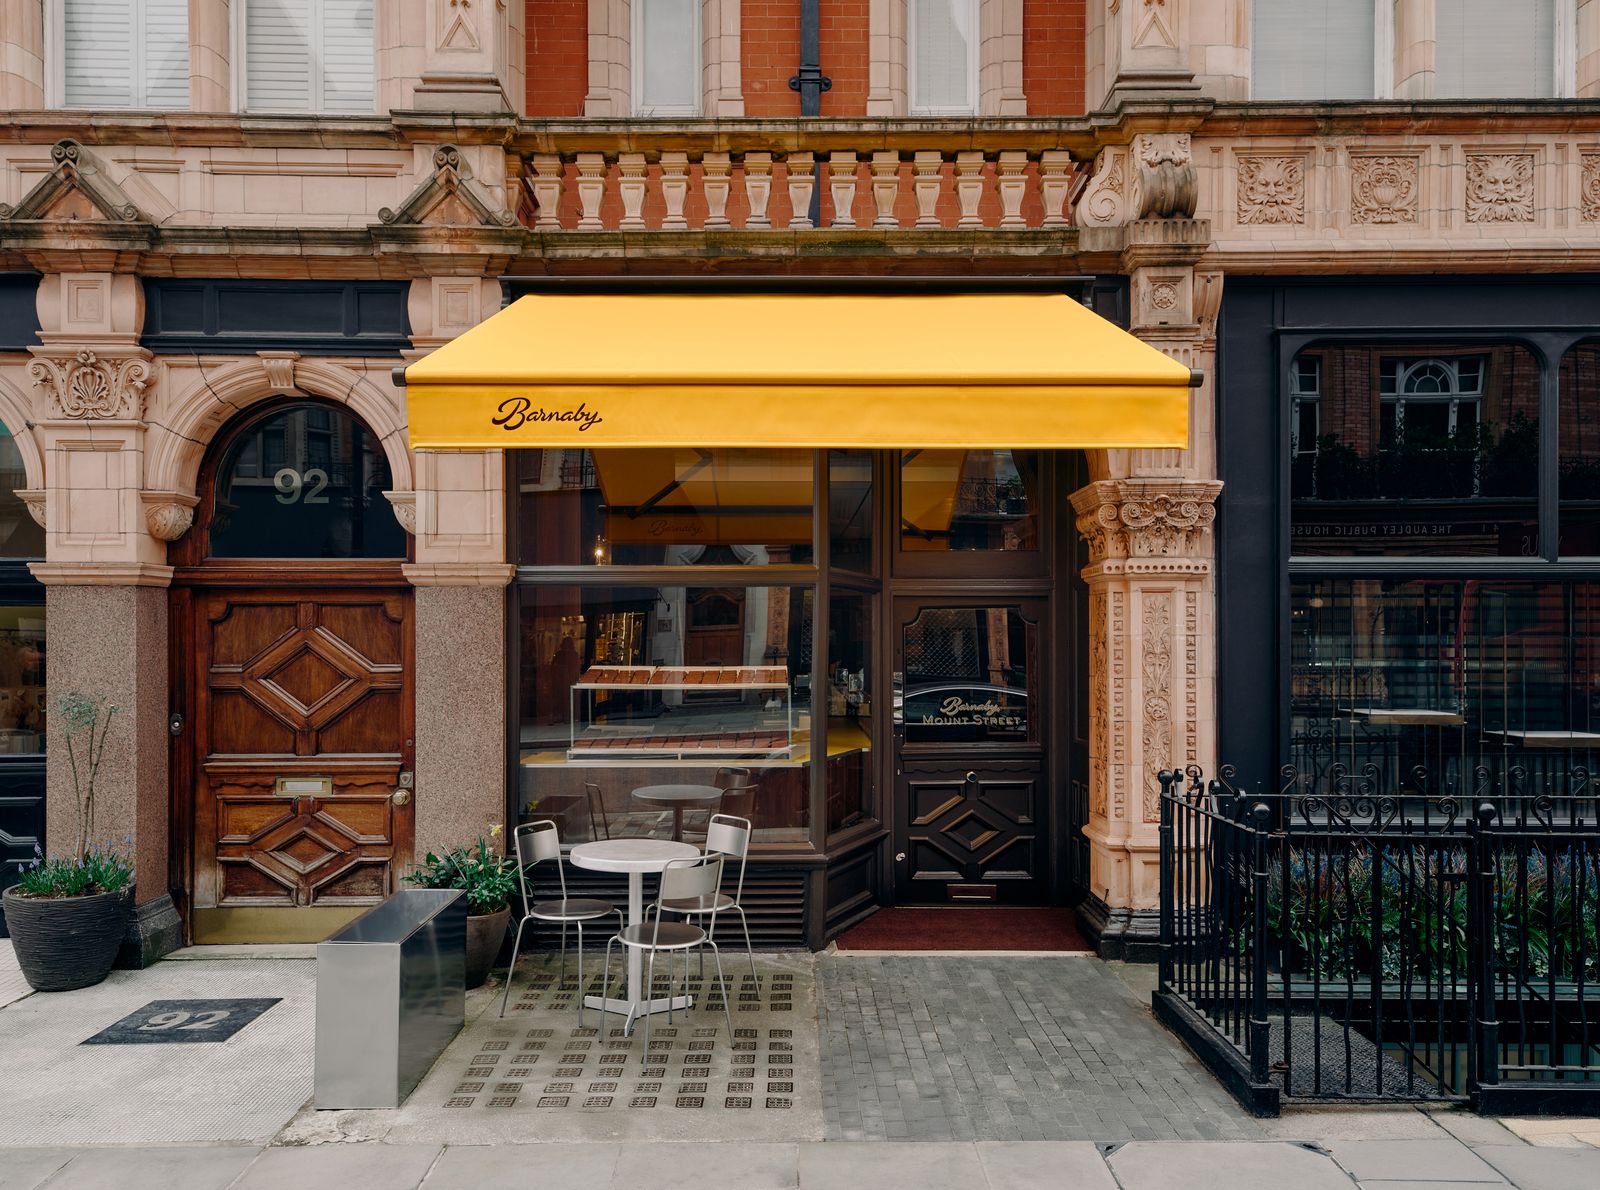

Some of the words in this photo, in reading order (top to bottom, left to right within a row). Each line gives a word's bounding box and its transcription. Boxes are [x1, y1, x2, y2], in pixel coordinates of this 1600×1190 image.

[491, 397, 603, 432] Barnaby
[273, 467, 329, 505] 92
[940, 696, 1001, 717] Barnaby
[922, 714, 970, 726] MOUNT
[973, 714, 1021, 727] STREET
[138, 1010, 231, 1031] 92
